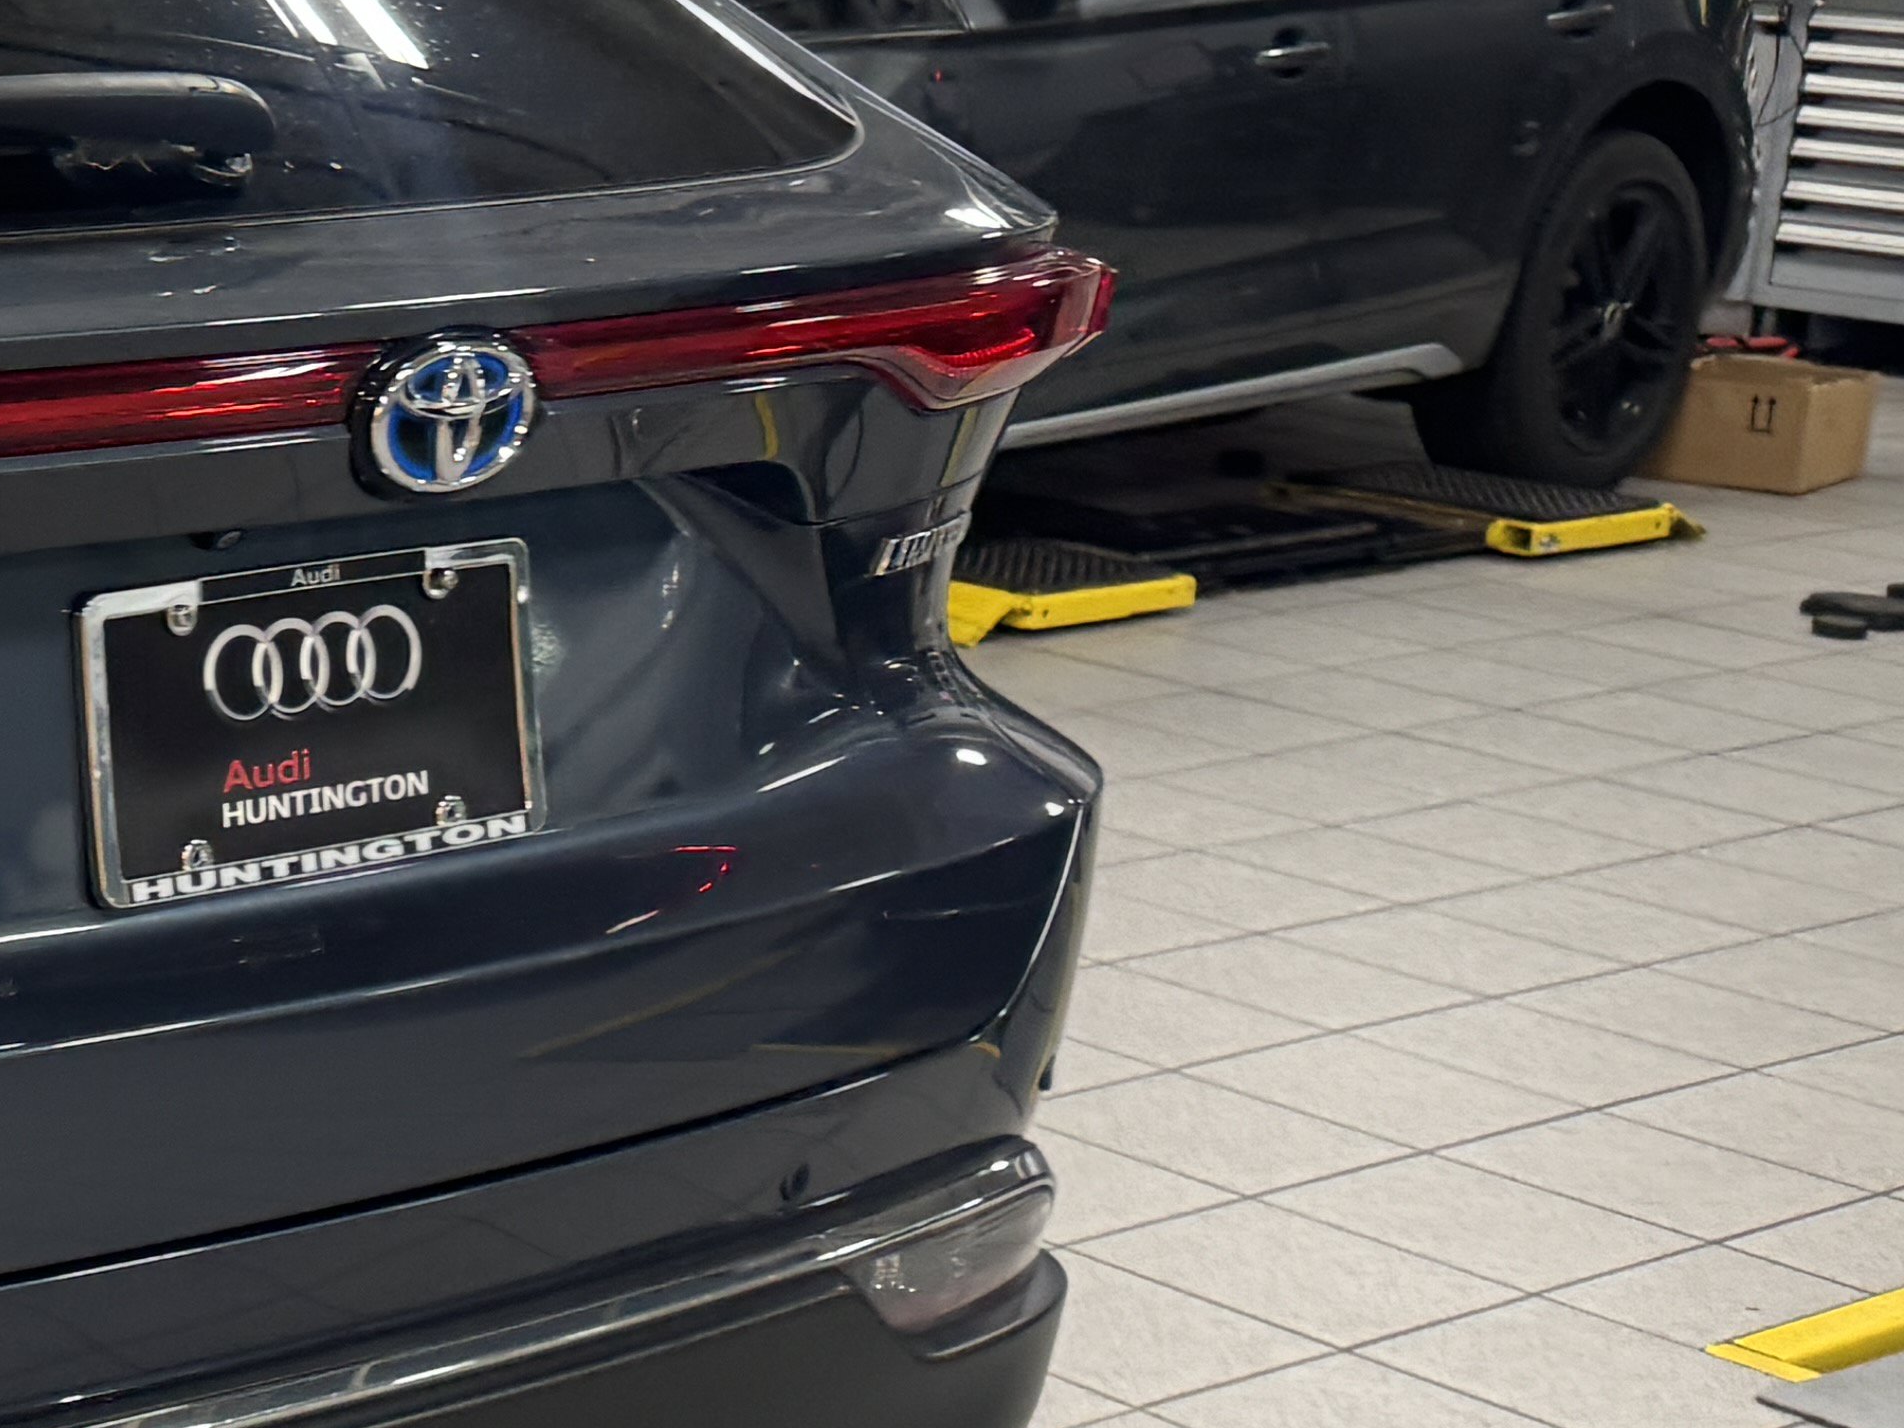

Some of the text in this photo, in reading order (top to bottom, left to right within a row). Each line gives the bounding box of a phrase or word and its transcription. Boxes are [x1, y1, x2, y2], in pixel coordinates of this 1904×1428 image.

[291, 564, 340, 587] Audi
[222, 748, 310, 793] Audi
[222, 770, 429, 828] HUNTINGTON
[132, 814, 529, 903] HUNTINGTON
